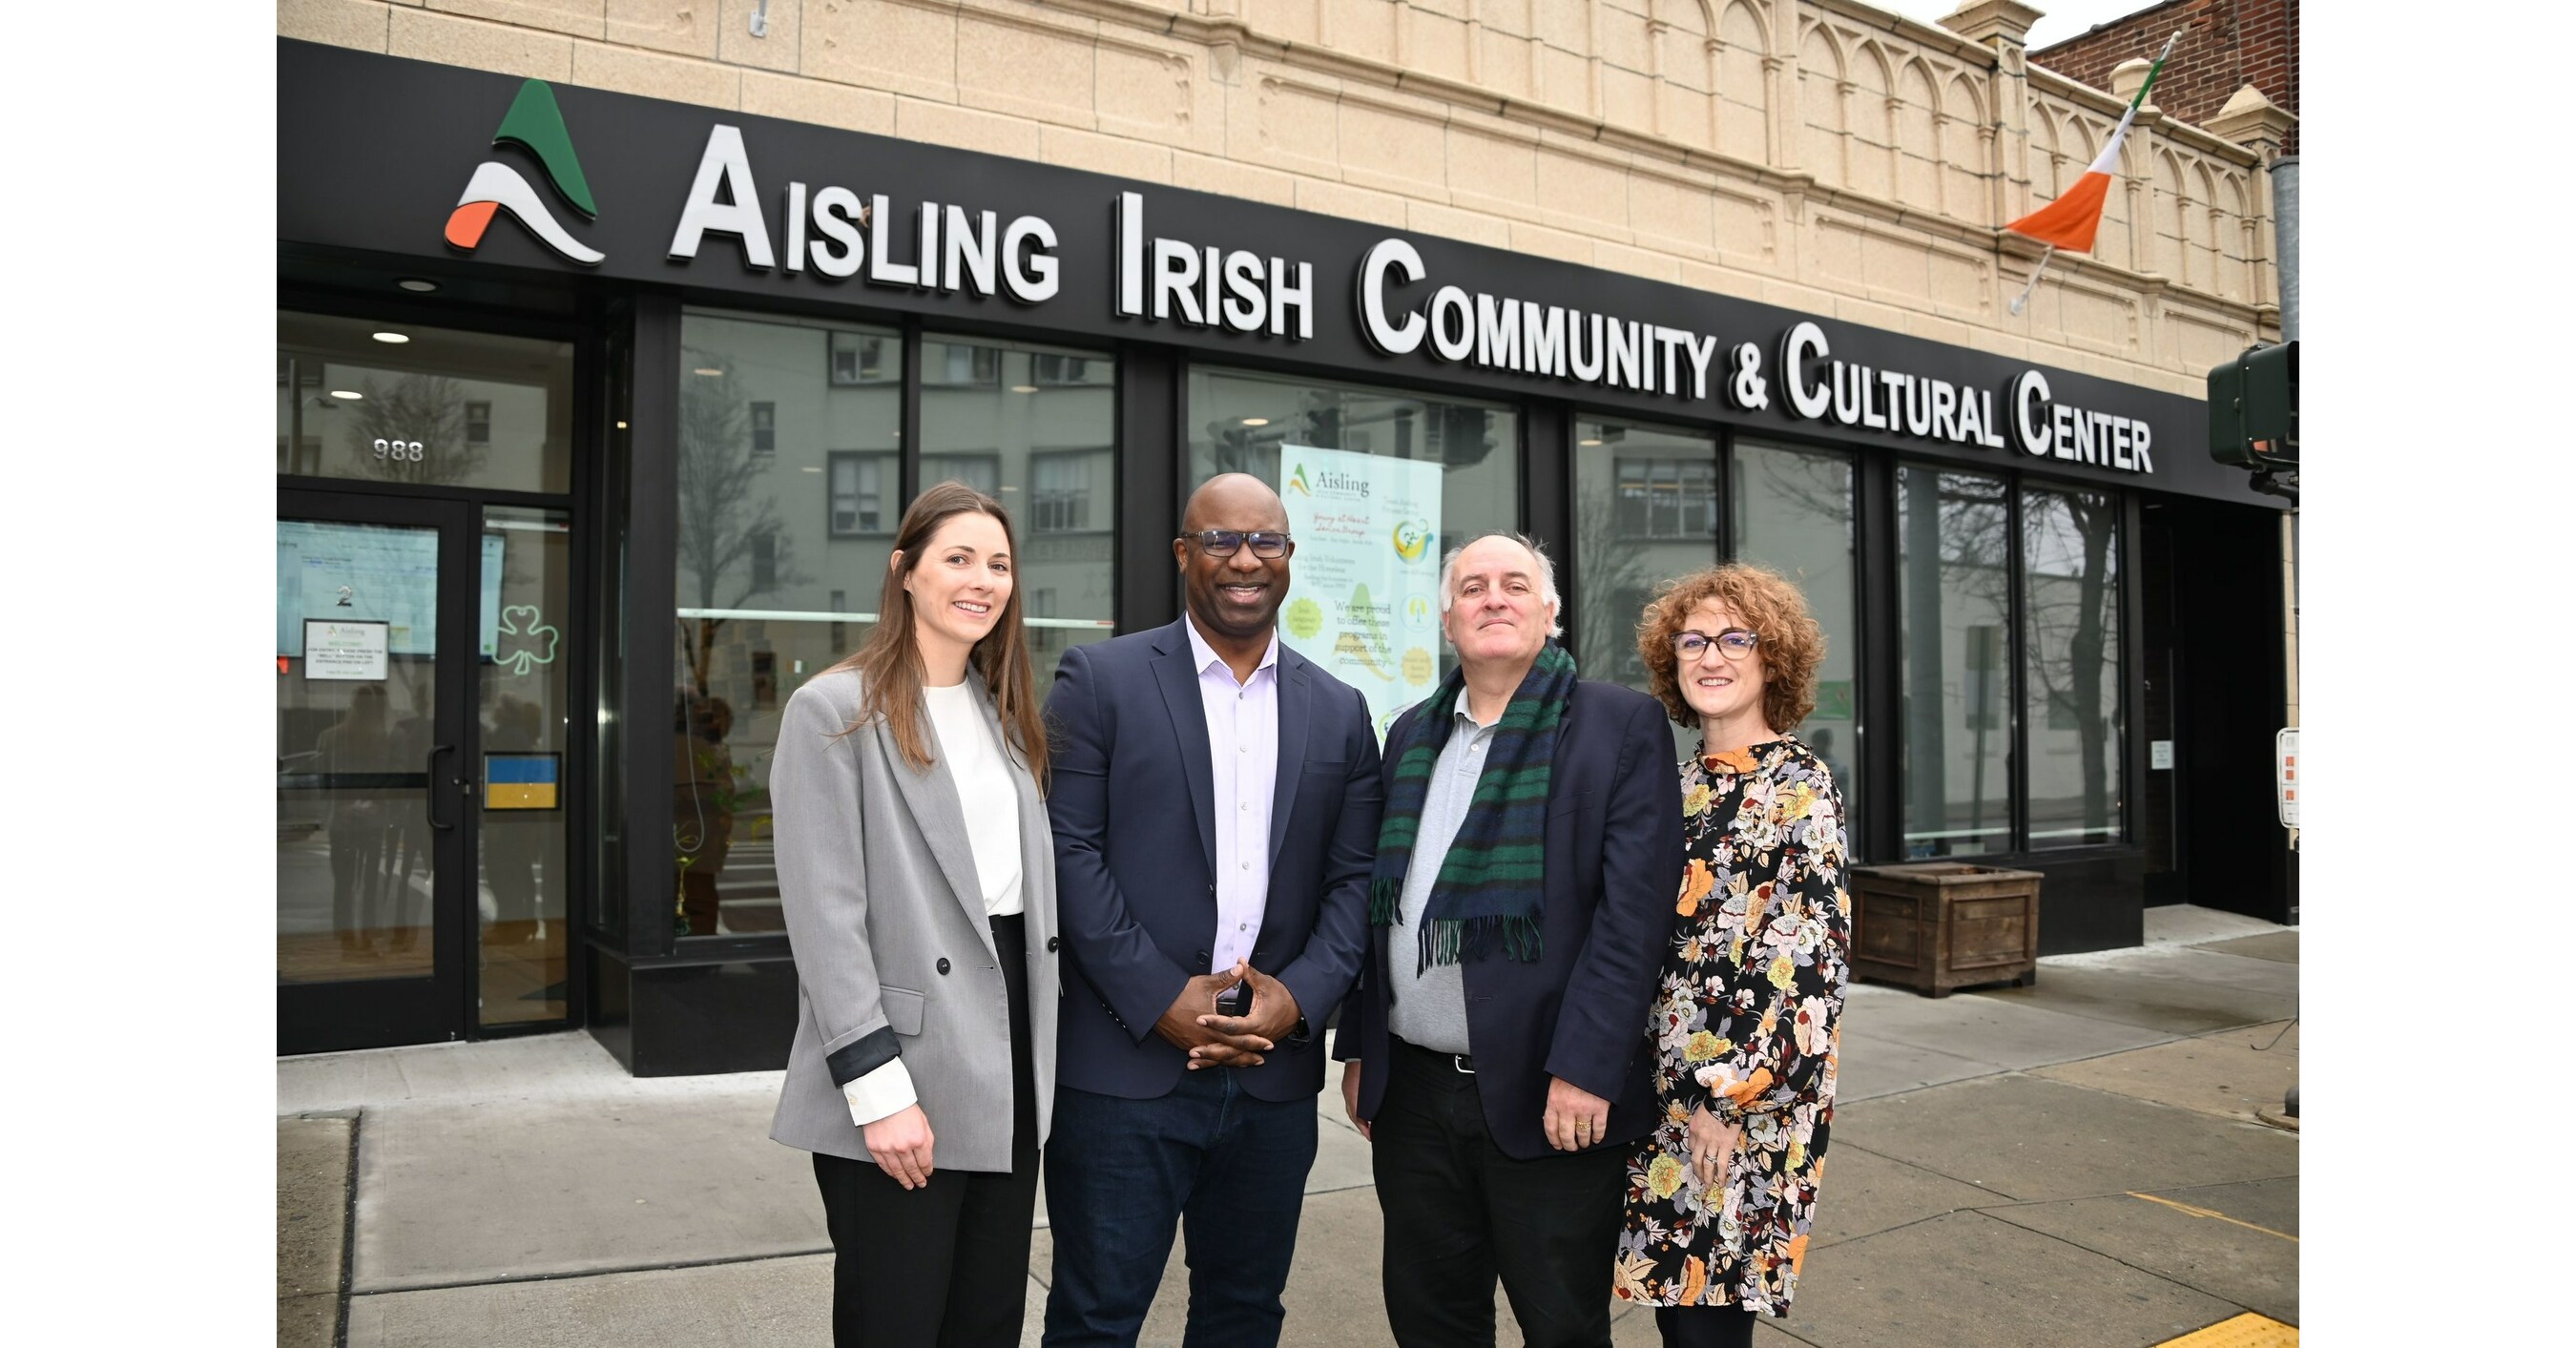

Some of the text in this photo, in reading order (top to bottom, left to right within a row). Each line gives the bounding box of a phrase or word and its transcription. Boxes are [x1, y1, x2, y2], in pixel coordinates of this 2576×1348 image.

[668, 124, 2154, 474] AISLING IRISH COMMUNITY & CULTURAL CENTER
[373, 438, 424, 462] 988
[1316, 471, 1369, 498] Aisling
[337, 585, 352, 607] 2
[1334, 599, 1350, 612] We
[1366, 604, 1391, 615] proud
[1337, 616, 1345, 625] to
[1347, 614, 1366, 626] offer
[1339, 632, 1388, 641] programs in
[1335, 642, 1392, 654] support of the
[1339, 657, 1385, 668] community
